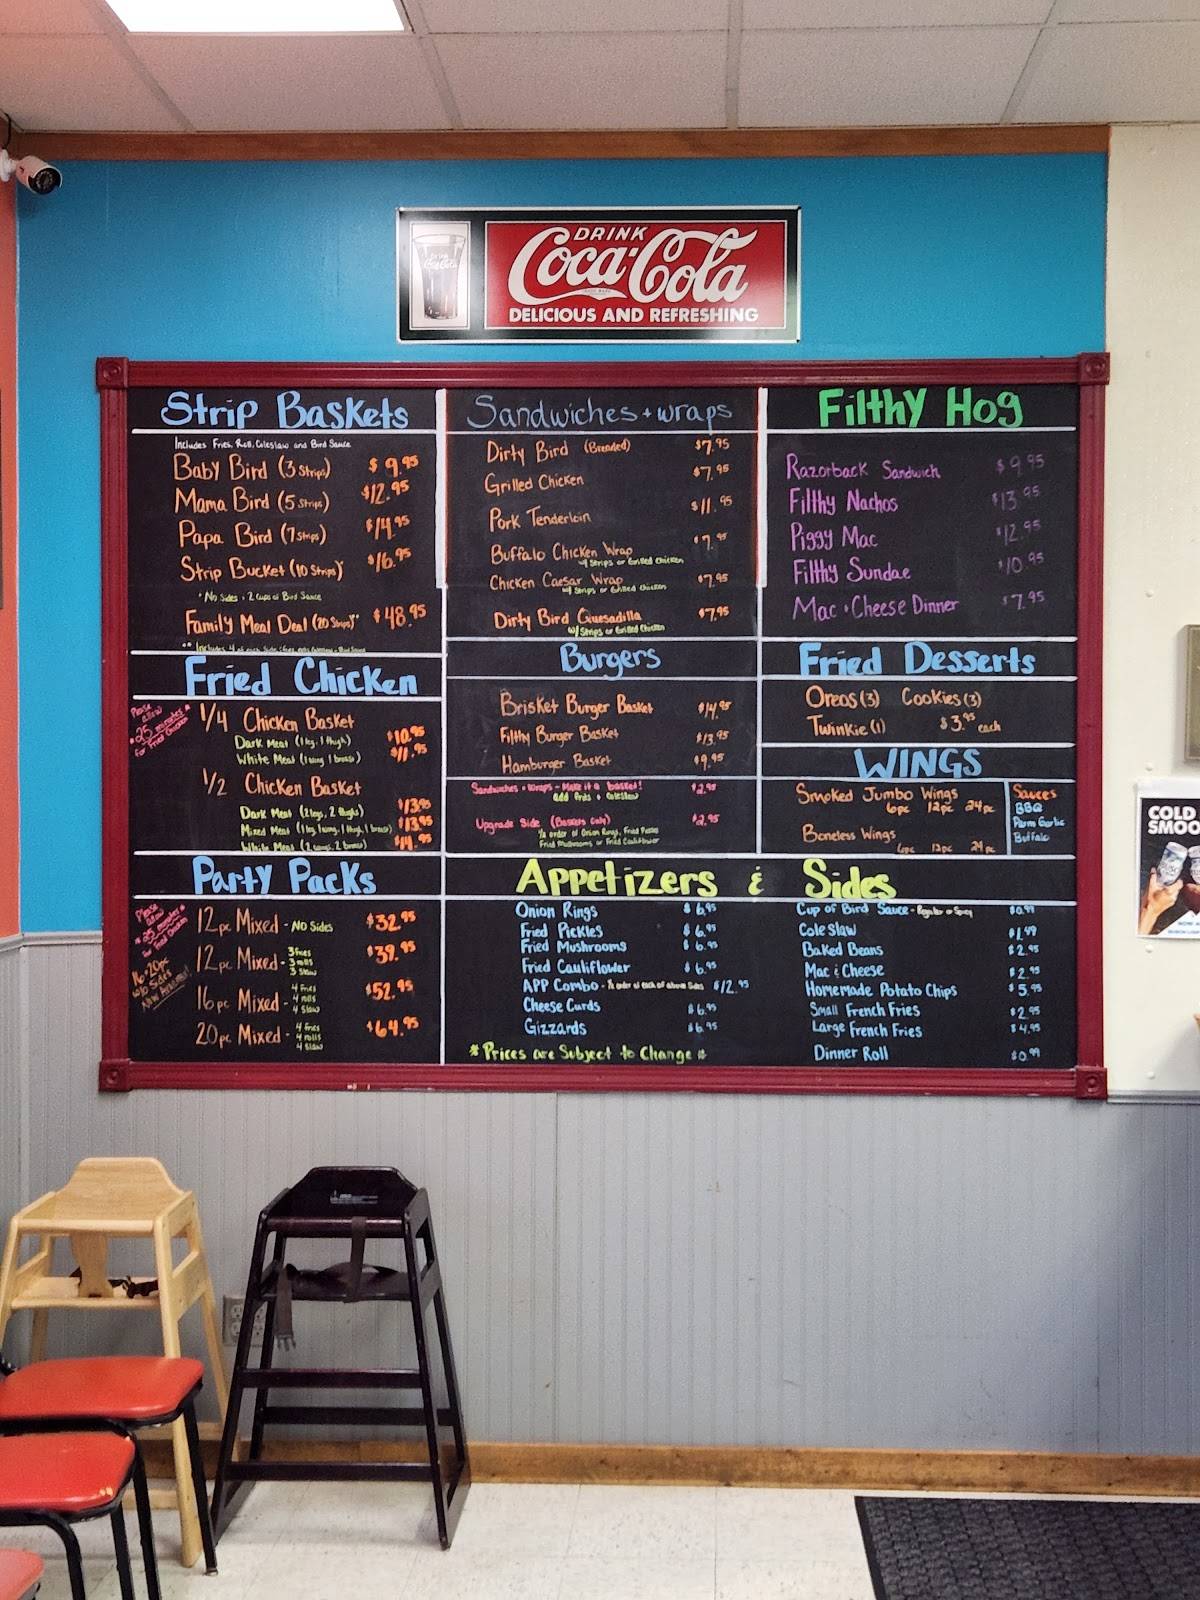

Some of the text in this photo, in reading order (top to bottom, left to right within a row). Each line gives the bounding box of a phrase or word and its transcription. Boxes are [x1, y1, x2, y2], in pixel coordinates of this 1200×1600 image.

[573, 226, 649, 242] DRINK
[507, 225, 759, 306] Coca-Cola
[508, 306, 759, 323] DELICIOUS AND REFRESHING
[161, 391, 408, 429] Strip Baskets
[467, 395, 637, 429] Sandwiches
[818, 387, 1023, 428] Filthy Hog
[175, 437, 351, 449] Includes and Bird Sauce
[487, 439, 730, 465] Dirty Bird $7.95
[174, 453, 267, 481] Baby Bird
[786, 453, 941, 480] Razorback Sandwich
[485, 464, 729, 495] Grilled Chicken $7.95
[175, 481, 409, 514] Mama Bird $12.95
[789, 488, 898, 515] Filthy Nachos
[490, 506, 590, 532] Pork Tenderloin
[179, 520, 272, 550] Papa Bird
[791, 522, 878, 551] Piggy Mac
[180, 548, 411, 582] Strip Bucket $16.95
[491, 542, 633, 565] Buffalo Chicken Wrap
[490, 572, 728, 591] Chicken Caesar Wrap $7.95
[793, 557, 911, 584] Filthy Sundae
[205, 592, 217, 602] No
[793, 594, 959, 622] Mac Cheese Dinner
[185, 609, 233, 635] Family
[240, 614, 270, 634] Meal
[277, 614, 308, 634] Deal
[494, 606, 729, 631] Dirty Bird $7.95
[560, 642, 661, 680] Burgers
[799, 641, 1035, 676] Fried Desserts
[184, 656, 418, 696] Fried Chicken
[501, 690, 654, 720] Brisket Burger Basket
[901, 687, 961, 707] Cookies
[200, 702, 228, 733] 1/4
[243, 707, 298, 733] Chicken
[305, 707, 355, 731] Basket
[807, 715, 1000, 737] Twinkie each
[235, 735, 289, 750] Dark Meat
[535, 725, 619, 749] Burger Basket
[237, 753, 295, 766] White Meat
[502, 755, 565, 776] Hamburger
[573, 753, 612, 767] Basket
[854, 749, 982, 779] WINGS
[202, 768, 362, 797] 1/2 Chicken Basket
[796, 783, 958, 804] Smoked Jumbo Wings
[240, 806, 292, 820] Dark Meat
[1015, 802, 1043, 814] BBQ
[1148, 805, 1197, 821] COLD
[241, 824, 290, 836] Mixed Meat
[476, 818, 540, 836] Upgrade Side
[802, 824, 897, 844] Boneless Wings
[193, 855, 377, 895] Party Packs
[516, 858, 718, 897] Appetizers
[802, 858, 897, 899] Sides
[197, 906, 232, 937] 12pc
[236, 908, 279, 935] Mixed
[310, 919, 333, 932] Sides
[366, 910, 416, 932] $32.95
[515, 902, 598, 920] Onion Rings
[796, 903, 909, 917] Cup Bird Sauce
[521, 923, 603, 938] Fried Pickles
[196, 944, 278, 972] 12pc Mixed
[521, 939, 627, 954] Fried Mushrooms
[802, 942, 883, 957] Baked Beans
[522, 958, 630, 975] Fried Cauliflower
[805, 962, 884, 978] Mac Cheese
[523, 979, 599, 993] APP Combo
[805, 981, 958, 998] Homemade Potato Chips
[197, 985, 279, 1013] 16pc Mixed
[523, 998, 601, 1013] Cheese Curds
[810, 1002, 920, 1018] Small French Fries
[196, 1016, 419, 1048] 20pc Mixed $64.95
[525, 1018, 587, 1035] Gizzards
[812, 1020, 923, 1039] Large French Fries
[533, 1042, 692, 1063] are Subject to Change
[814, 1045, 888, 1061] Dinner Roll
